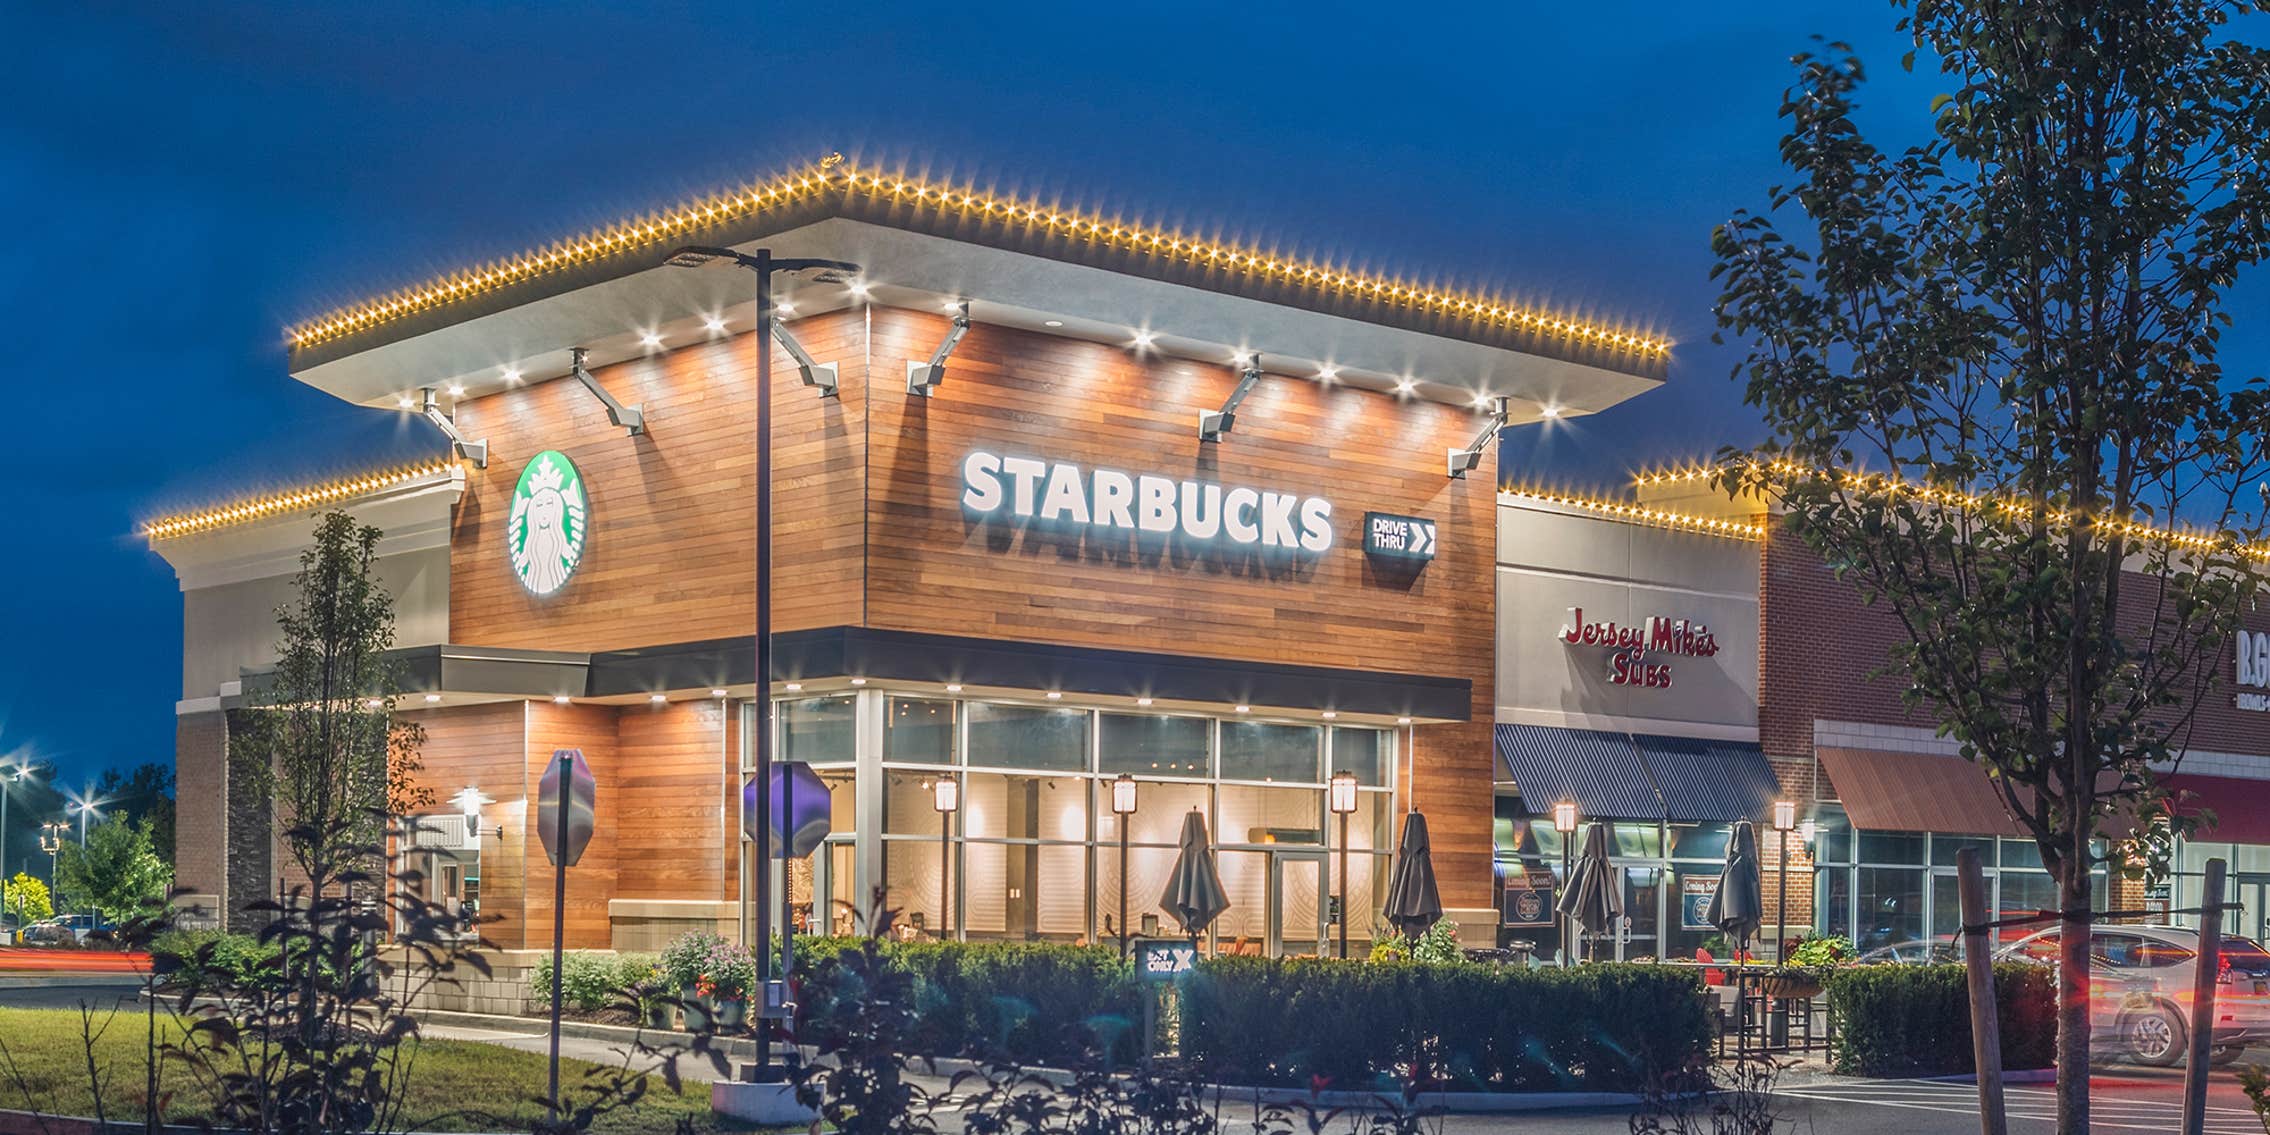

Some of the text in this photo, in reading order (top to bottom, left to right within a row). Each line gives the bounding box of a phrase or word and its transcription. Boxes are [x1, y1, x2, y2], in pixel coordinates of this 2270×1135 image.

[963, 452, 1333, 552] STARBUCKS
[1373, 518, 1408, 537] DRIVE
[1373, 533, 1405, 550] THRU
[1559, 607, 1645, 660] Jersey
[1147, 960, 1174, 972] ONLY
